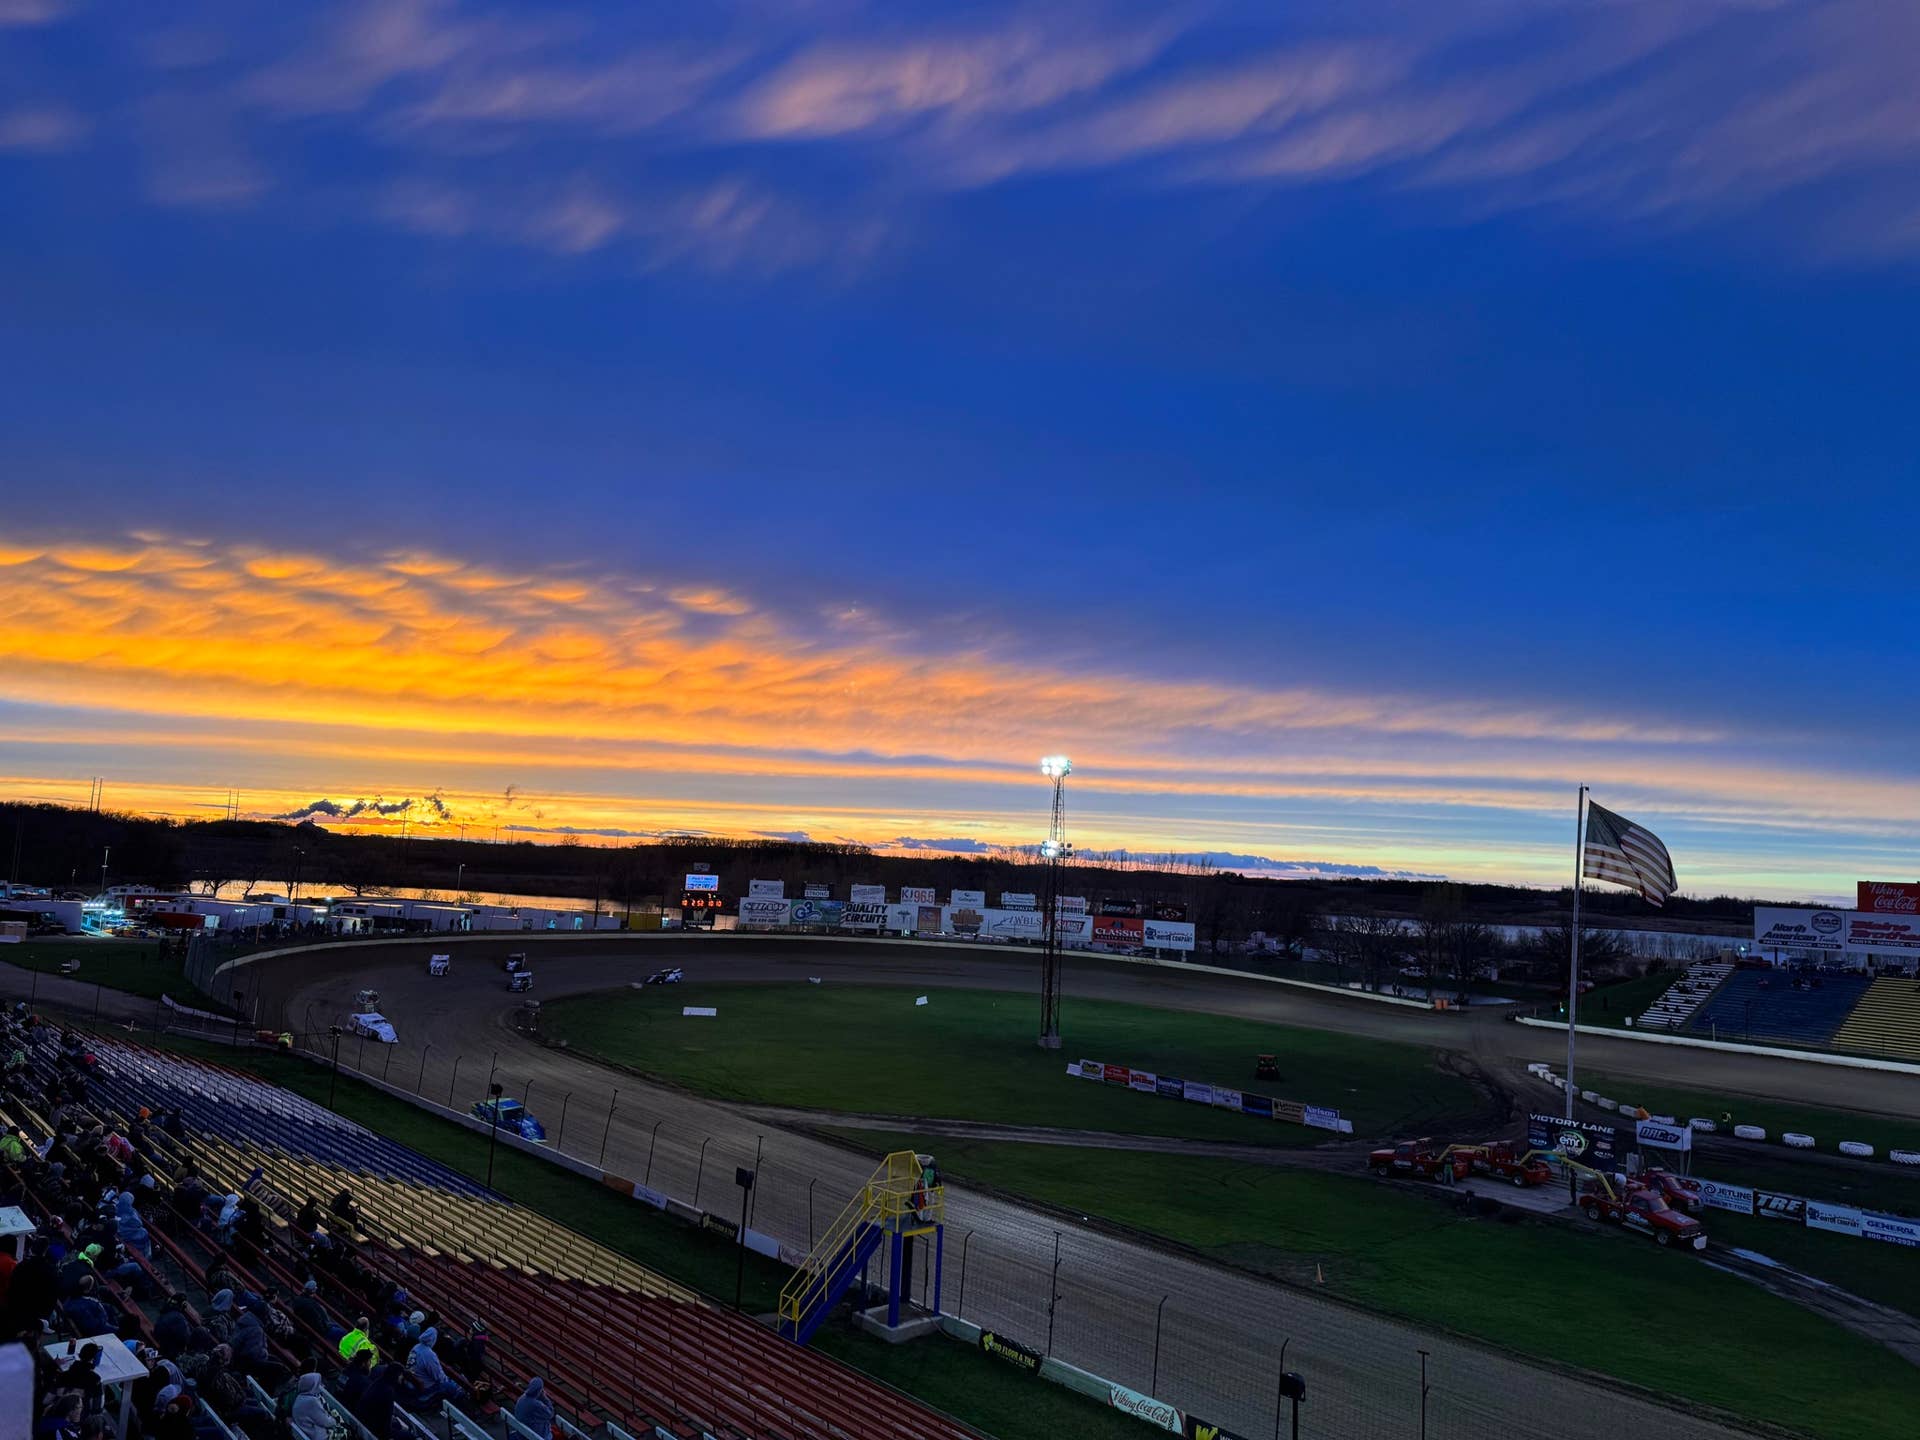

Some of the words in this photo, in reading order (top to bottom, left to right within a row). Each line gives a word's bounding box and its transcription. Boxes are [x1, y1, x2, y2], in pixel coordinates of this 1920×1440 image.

[1869, 884, 1905, 897] Viking
[845, 903, 888, 914] QUALITY
[845, 913, 888, 924] CIRCUITS
[1095, 927, 1142, 938] CLASSIC
[1772, 923, 1807, 933] North
[1172, 935, 1193, 943] COMPANY
[1763, 932, 1817, 942] American
[1306, 1105, 1336, 1117] Nelson
[1529, 1113, 1580, 1128] VICTORY
[1582, 1122, 1615, 1134] LANE
[1559, 1135, 1580, 1147] emr
[1717, 1188, 1752, 1200] JETLINE
[1867, 1220, 1916, 1236] GENERAL
[1114, 1390, 1136, 1411] Viking
